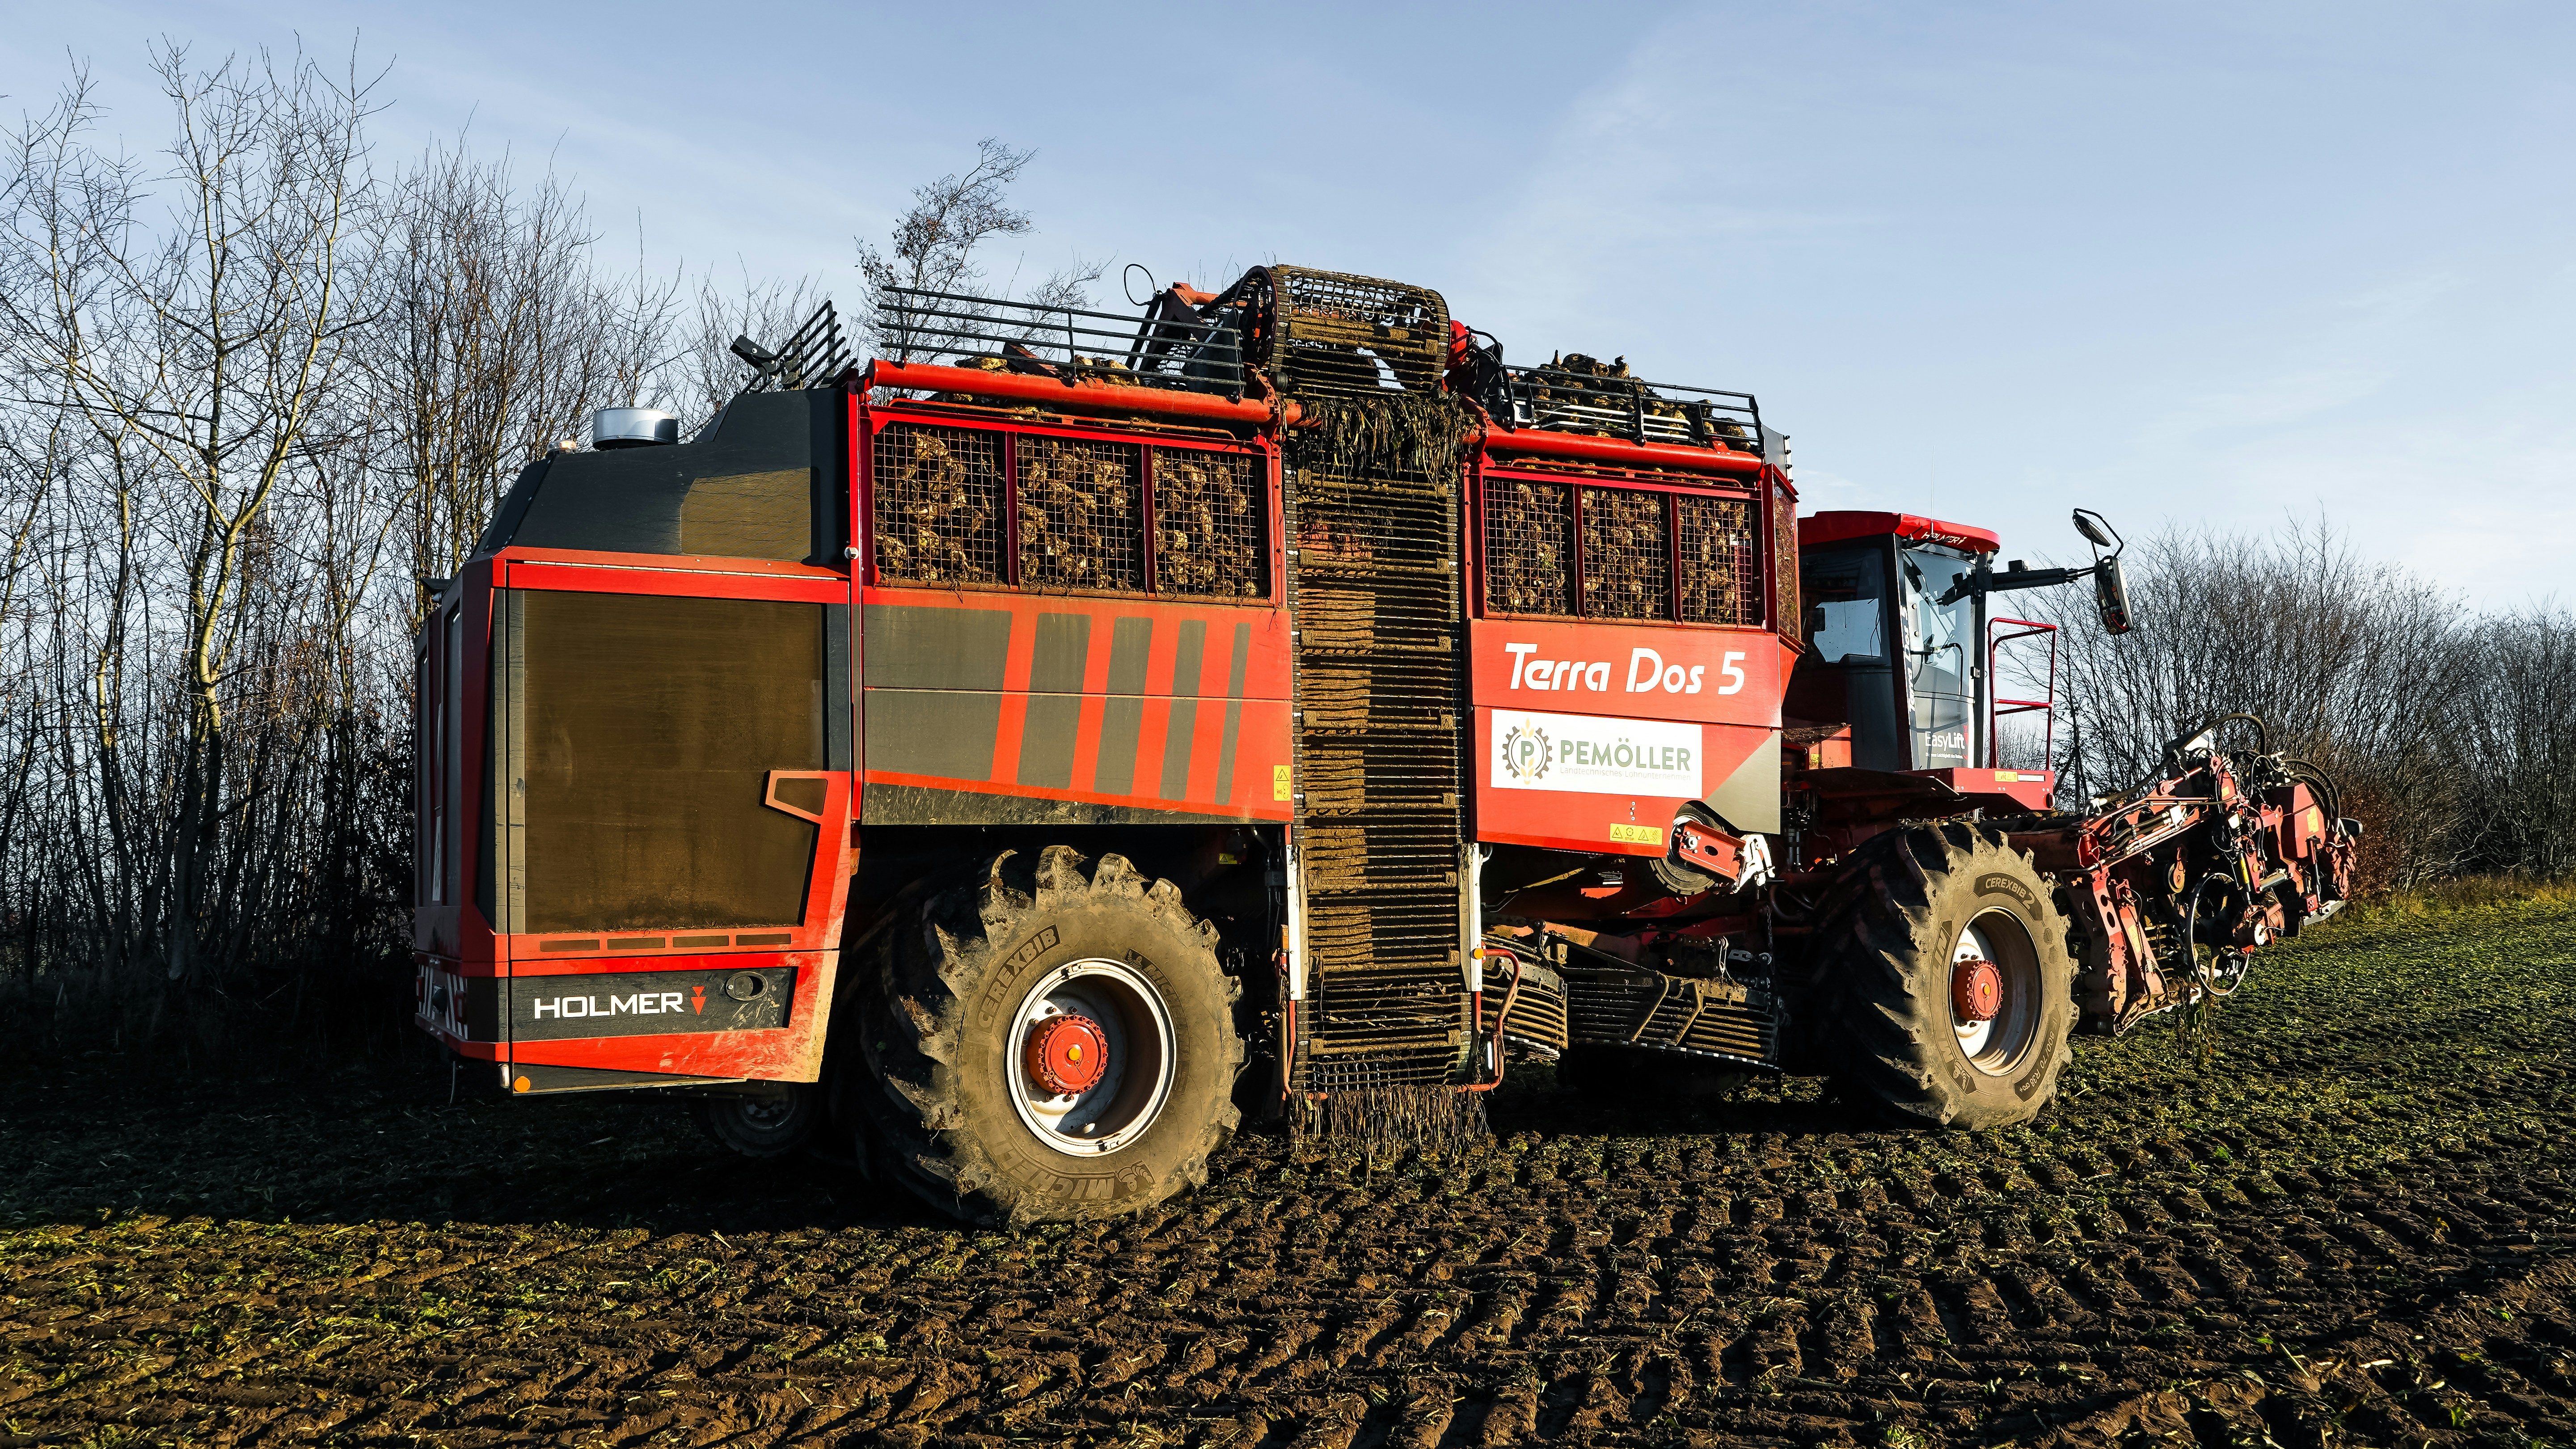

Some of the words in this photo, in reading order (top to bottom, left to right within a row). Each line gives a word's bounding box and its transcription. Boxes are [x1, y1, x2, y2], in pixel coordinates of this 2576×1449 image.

[1921, 532, 1960, 543] HOLMER
[1505, 642, 1611, 692] Terra
[1625, 647, 1705, 694] Dos
[1718, 651, 1745, 695] 5
[1521, 741, 1534, 766] P
[1560, 738, 1691, 771] PEMÖLLER
[1925, 731, 1965, 751] EasyLift
[1560, 767, 1622, 777] Landtechnisches
[1625, 771, 1691, 781] Lohnunternehmen
[1985, 877, 2027, 898] CEREXBIB
[2023, 892, 2035, 910] 2
[978, 929, 1056, 1028] CEREXBIB
[534, 992, 684, 1019] HOLMER
